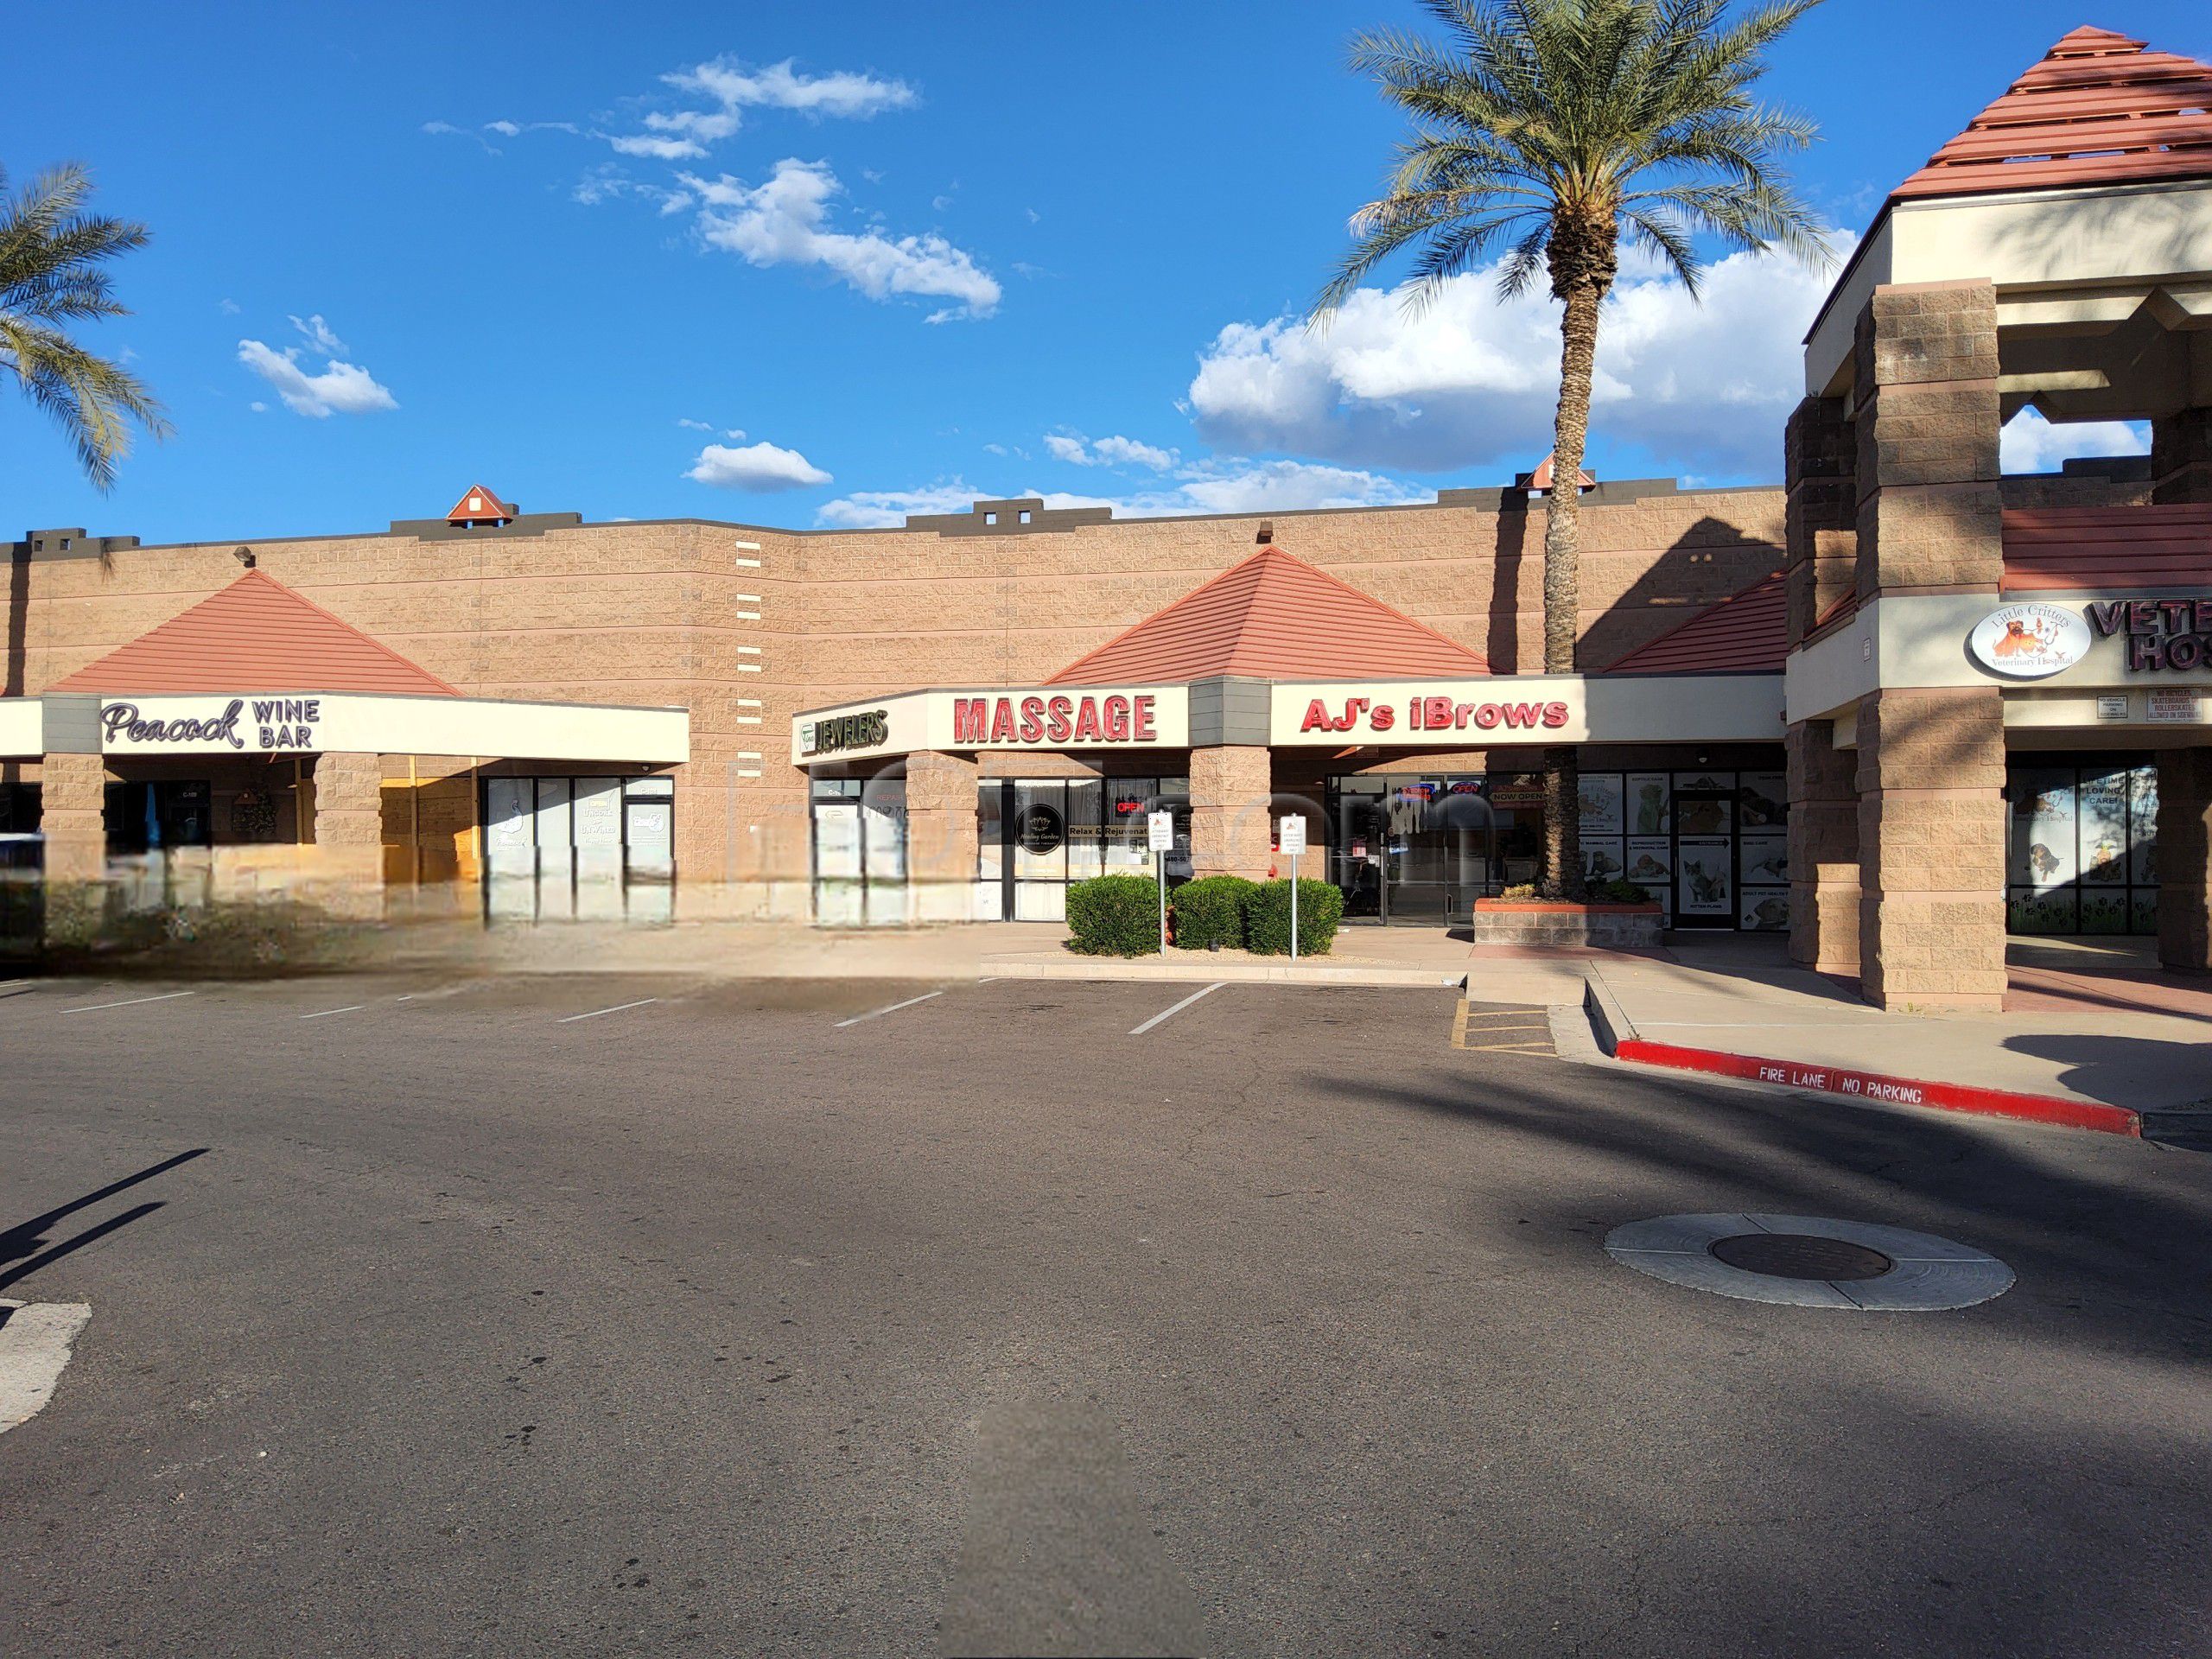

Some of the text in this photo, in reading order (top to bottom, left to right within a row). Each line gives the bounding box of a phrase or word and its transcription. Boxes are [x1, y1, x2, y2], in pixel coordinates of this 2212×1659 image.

[1992, 605, 2070, 628] Little Critters
[1992, 658, 2034, 667] Veterinary
[2129, 634, 2212, 671] HO
[100, 699, 245, 749] Peacock
[251, 698, 321, 724] WINE
[954, 695, 1158, 744] MASSAGE
[1300, 696, 1569, 733] AJ's iBrows
[259, 725, 312, 748] BAR
[817, 709, 888, 754] JEWELERS
[1117, 803, 1144, 813] OPEN
[1759, 1066, 1922, 1103] FIRE LANE NO PARKING
